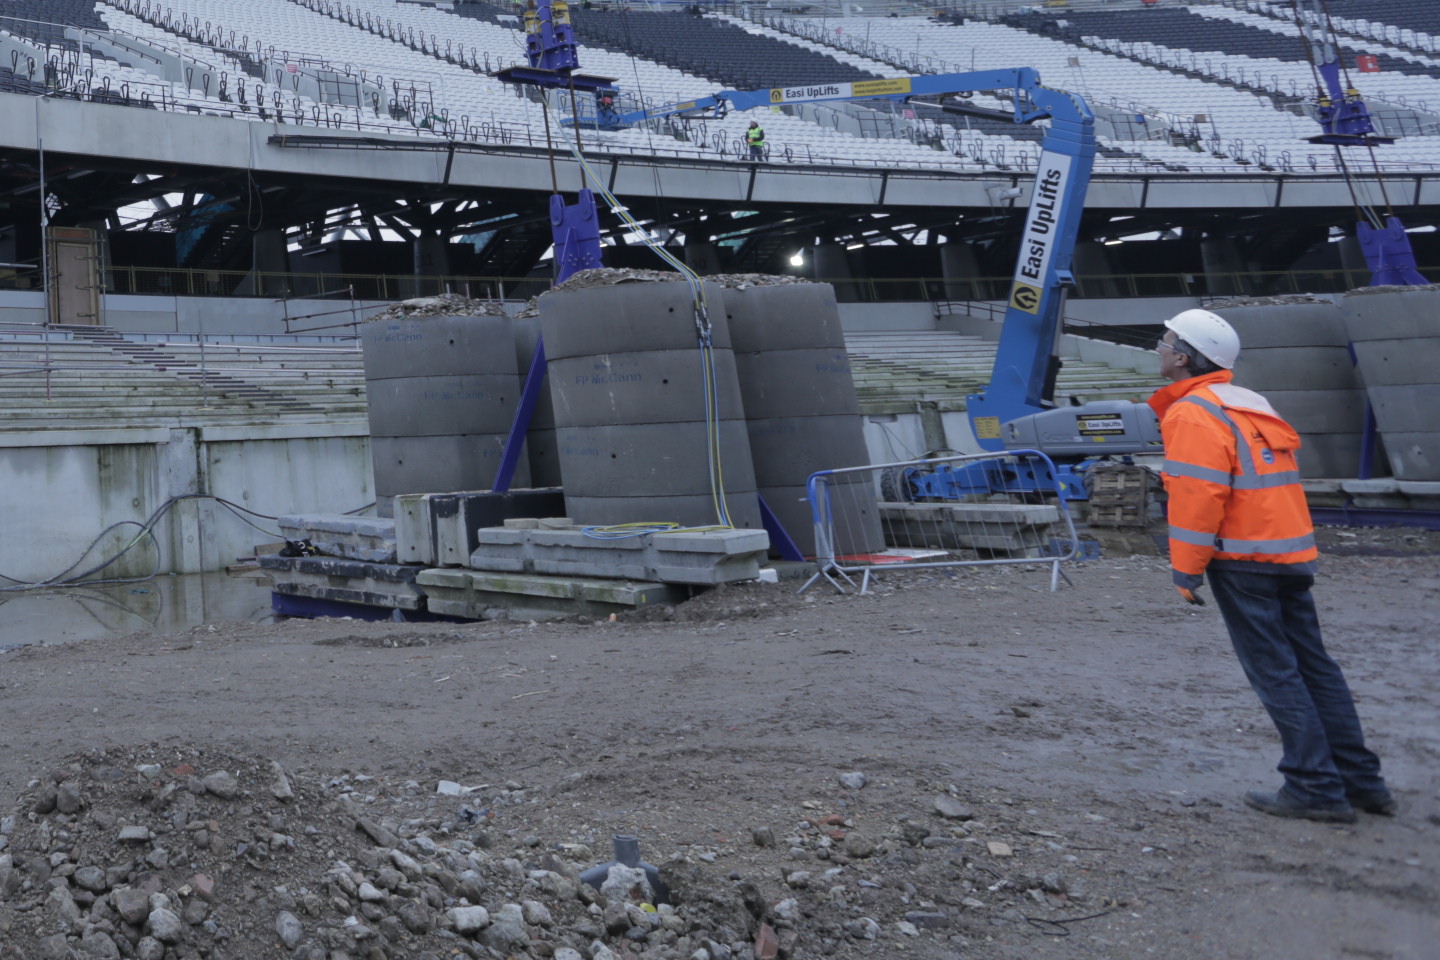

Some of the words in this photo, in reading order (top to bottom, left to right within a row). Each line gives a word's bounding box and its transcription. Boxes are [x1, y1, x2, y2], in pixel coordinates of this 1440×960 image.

[785, 88, 805, 99] Easi
[807, 85, 840, 99] UpLifts
[1030, 168, 1062, 235] UpLifts
[1021, 238, 1046, 280] Easi
[575, 376, 588, 385] FP
[591, 373, 642, 385] McCann
